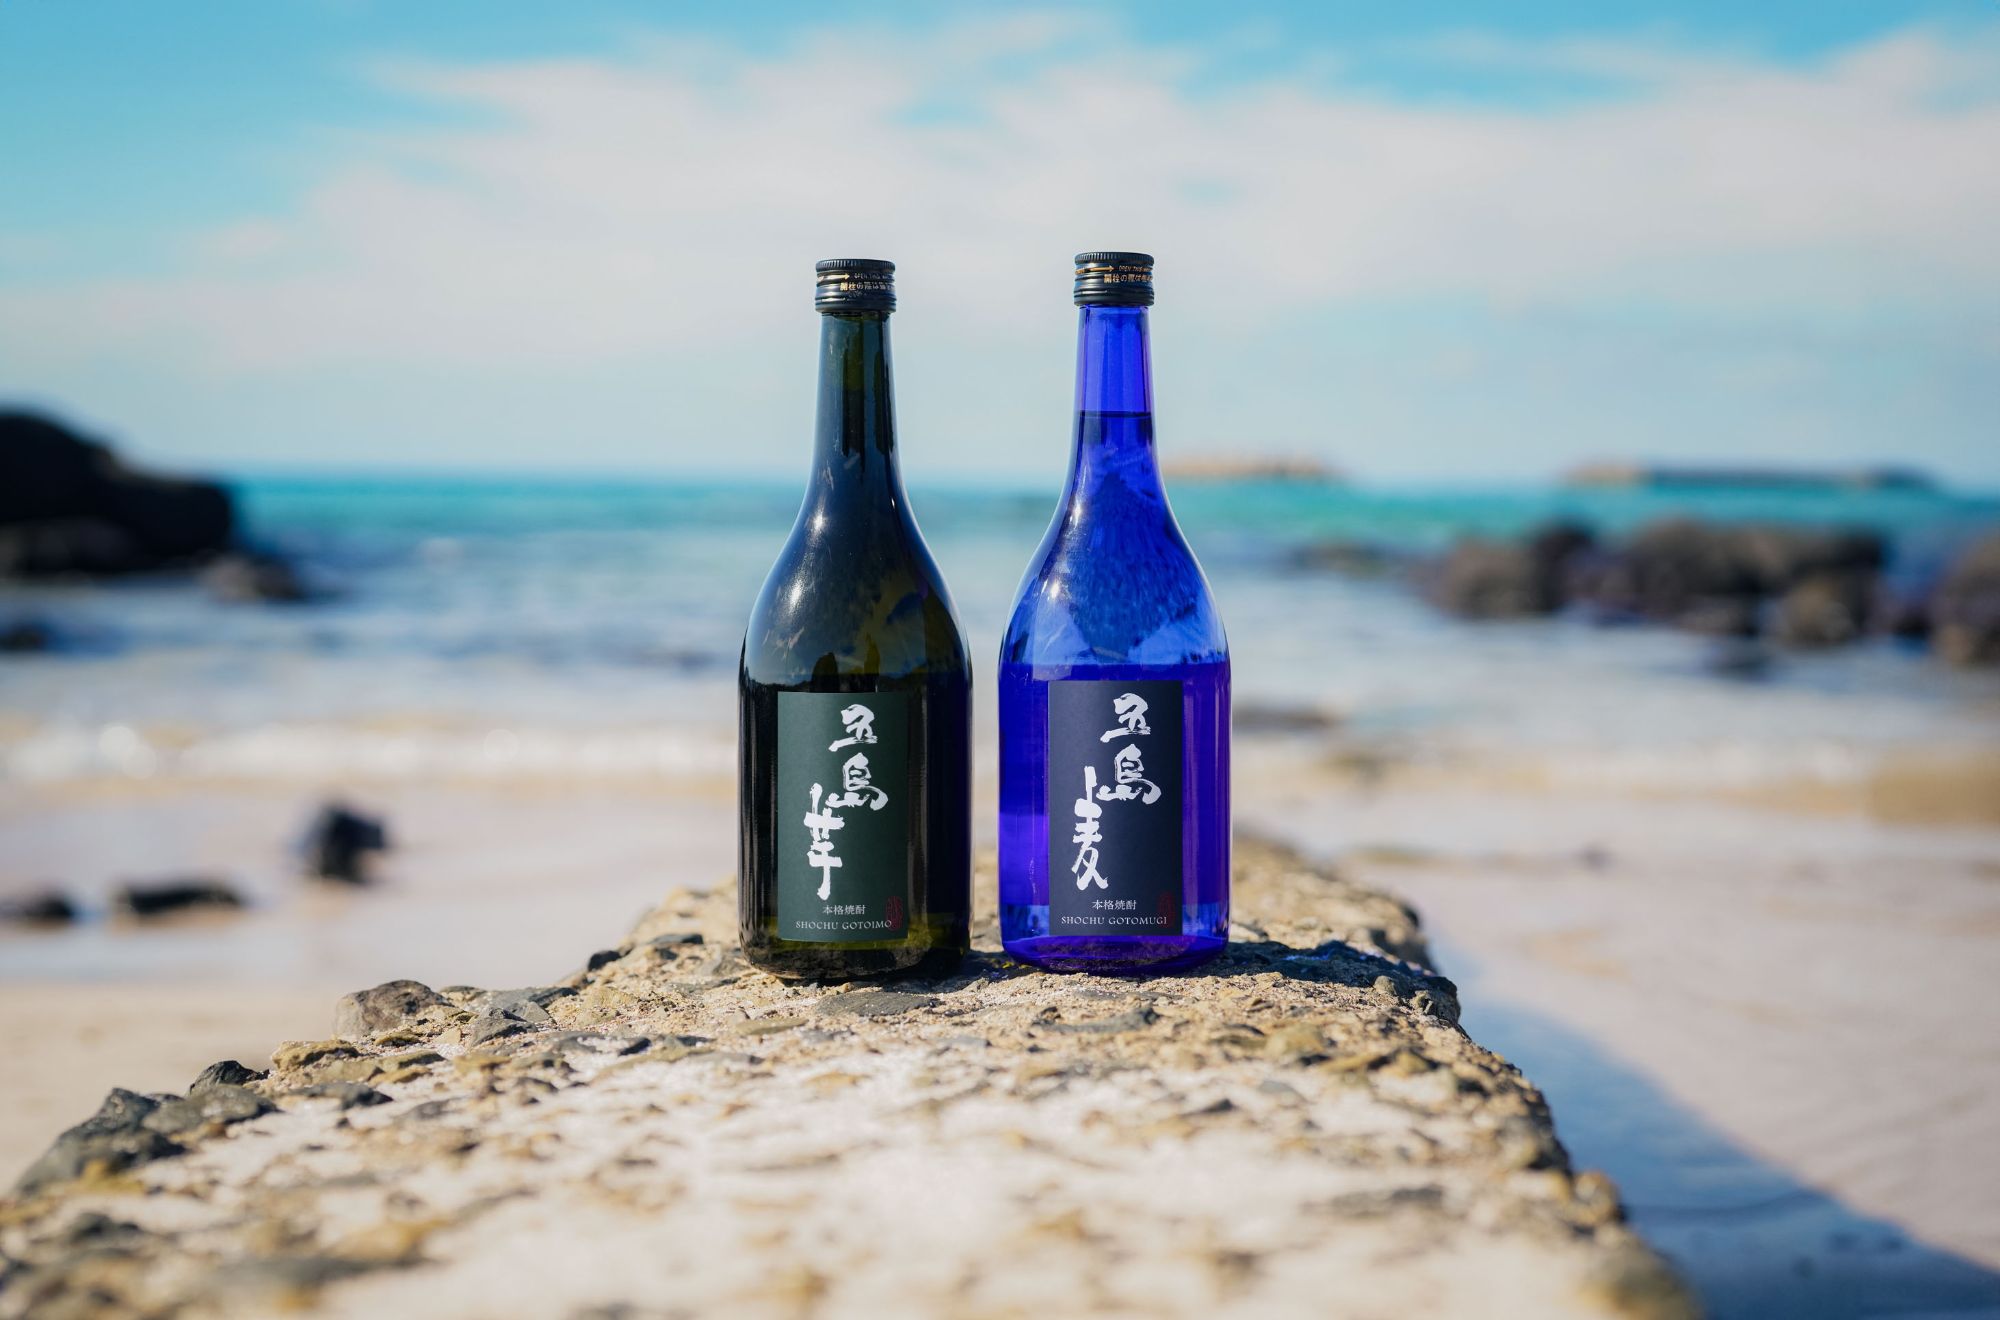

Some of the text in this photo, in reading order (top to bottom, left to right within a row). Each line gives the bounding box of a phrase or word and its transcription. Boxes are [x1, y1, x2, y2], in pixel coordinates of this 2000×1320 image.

[1071, 765, 1109, 891] 麦
[803, 782, 845, 901] 芋
[822, 904, 866, 915] 本格焼酎
[1092, 899, 1137, 910] 本格焼酎
[795, 919, 892, 930] SHOCHU GOTOIMO
[1061, 916, 1168, 925] SHOCHU GOTOMUGI
